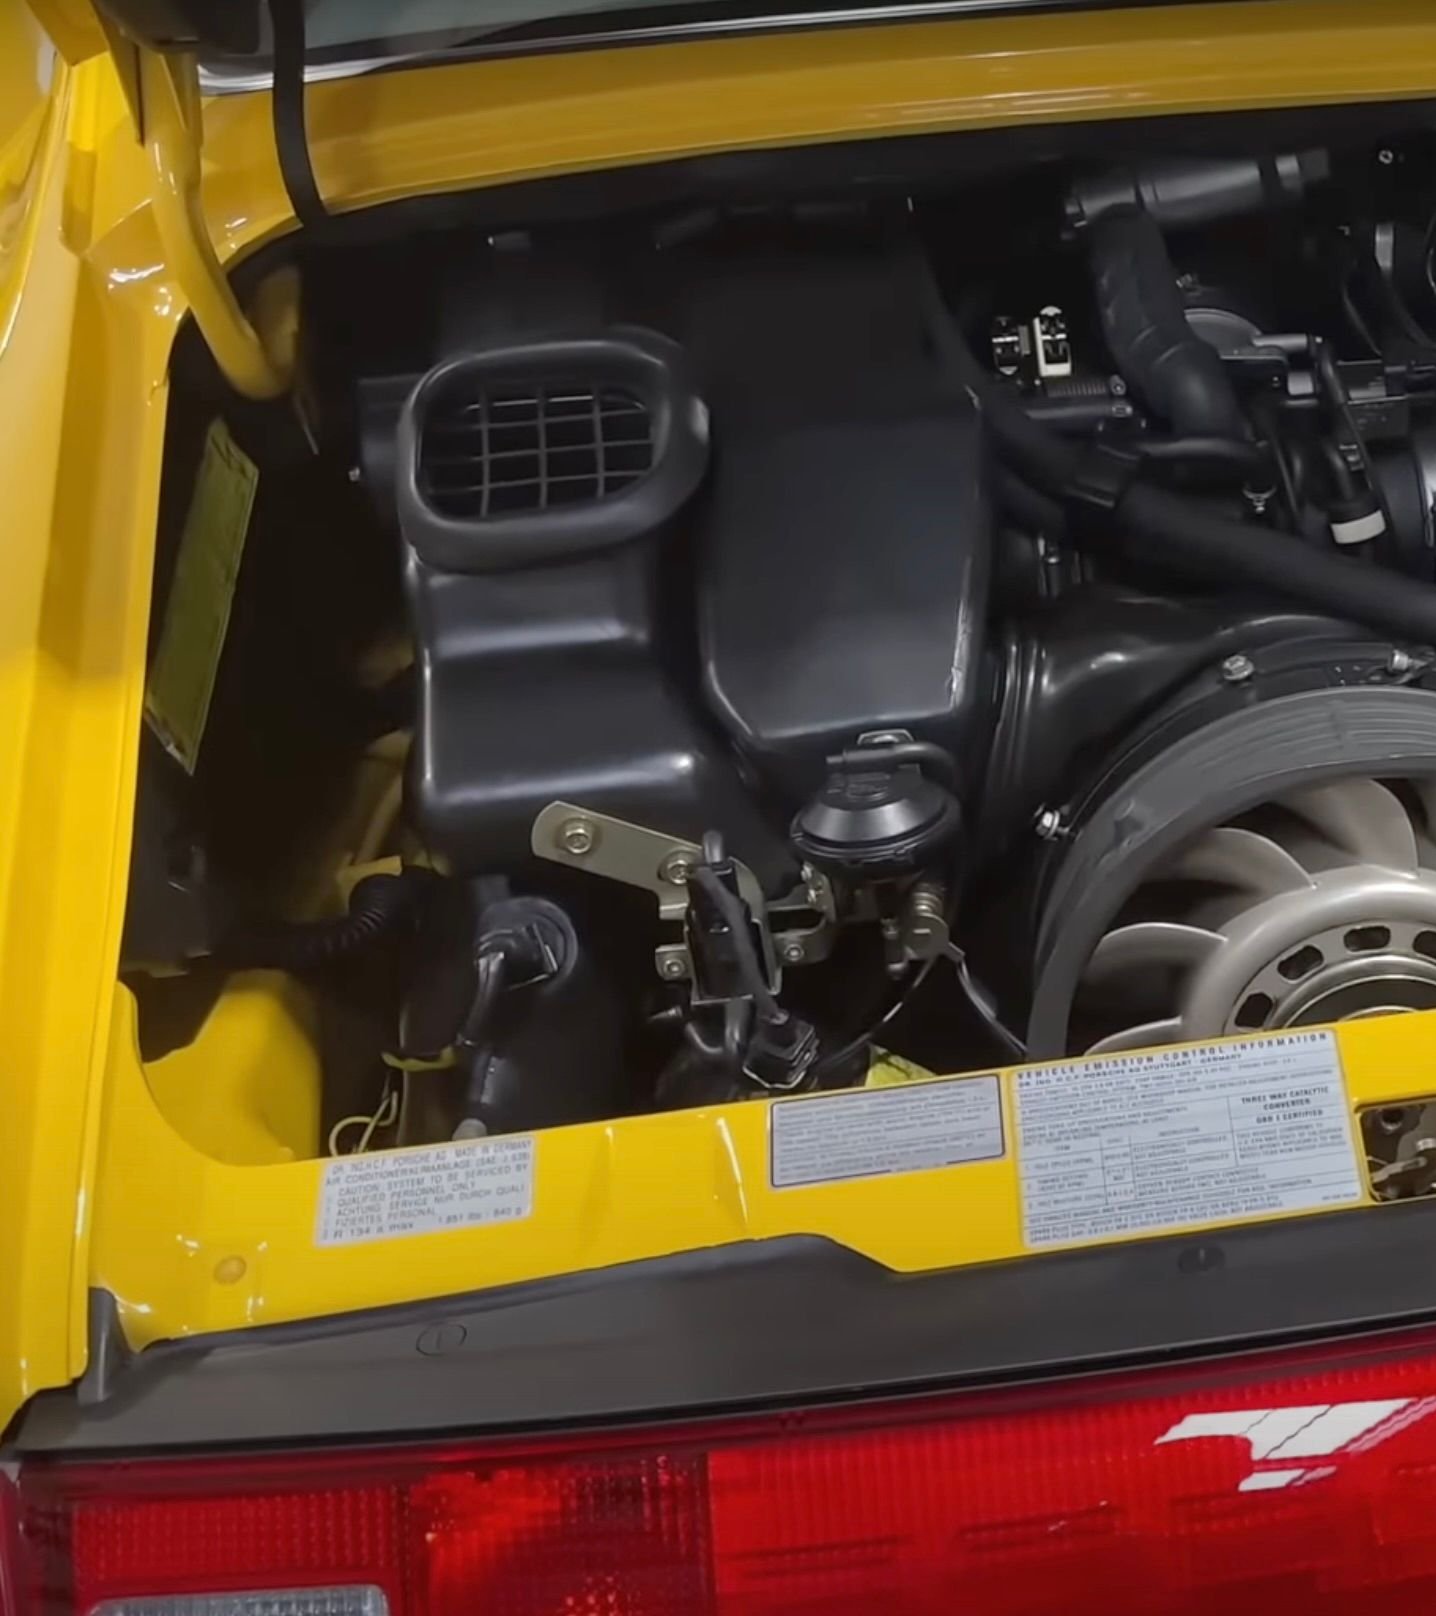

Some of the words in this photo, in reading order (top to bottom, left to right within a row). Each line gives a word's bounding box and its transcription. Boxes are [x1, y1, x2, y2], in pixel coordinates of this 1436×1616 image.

[1017, 1065, 1074, 1080] VEHICLE
[1085, 1056, 1154, 1072] EMISSION
[1163, 1046, 1224, 1062] CONTROL
[1233, 1033, 1328, 1052] INFORMATION
[1241, 1095, 1266, 1105] THREE
[1268, 1092, 1287, 1100] WAY
[1289, 1086, 1329, 1098] CATALYTIC
[1263, 1098, 1311, 1111] CONVERTER
[1282, 1109, 1323, 1121] CERTIFIED
[454, 1146, 476, 1158] MADE
[493, 1139, 531, 1153] GERMANY
[325, 1175, 341, 1187] AIR
[386, 1176, 425, 1190] SYSTEM
[430, 1174, 441, 1184] TO
[447, 1171, 458, 1181] BE
[464, 1164, 512, 1179] SERVICED
[515, 1161, 528, 1171] BY
[336, 1192, 385, 1208] QUALIFIED
[390, 1184, 445, 1200] PERSONNEL
[388, 1196, 428, 1210] SERVICE
[433, 1192, 454, 1203] NUR
[458, 1187, 491, 1200] DURCH
[334, 1212, 383, 1228] FIZIERTES
[386, 1205, 435, 1221] PERSONAL
[349, 1226, 371, 1237] 134
